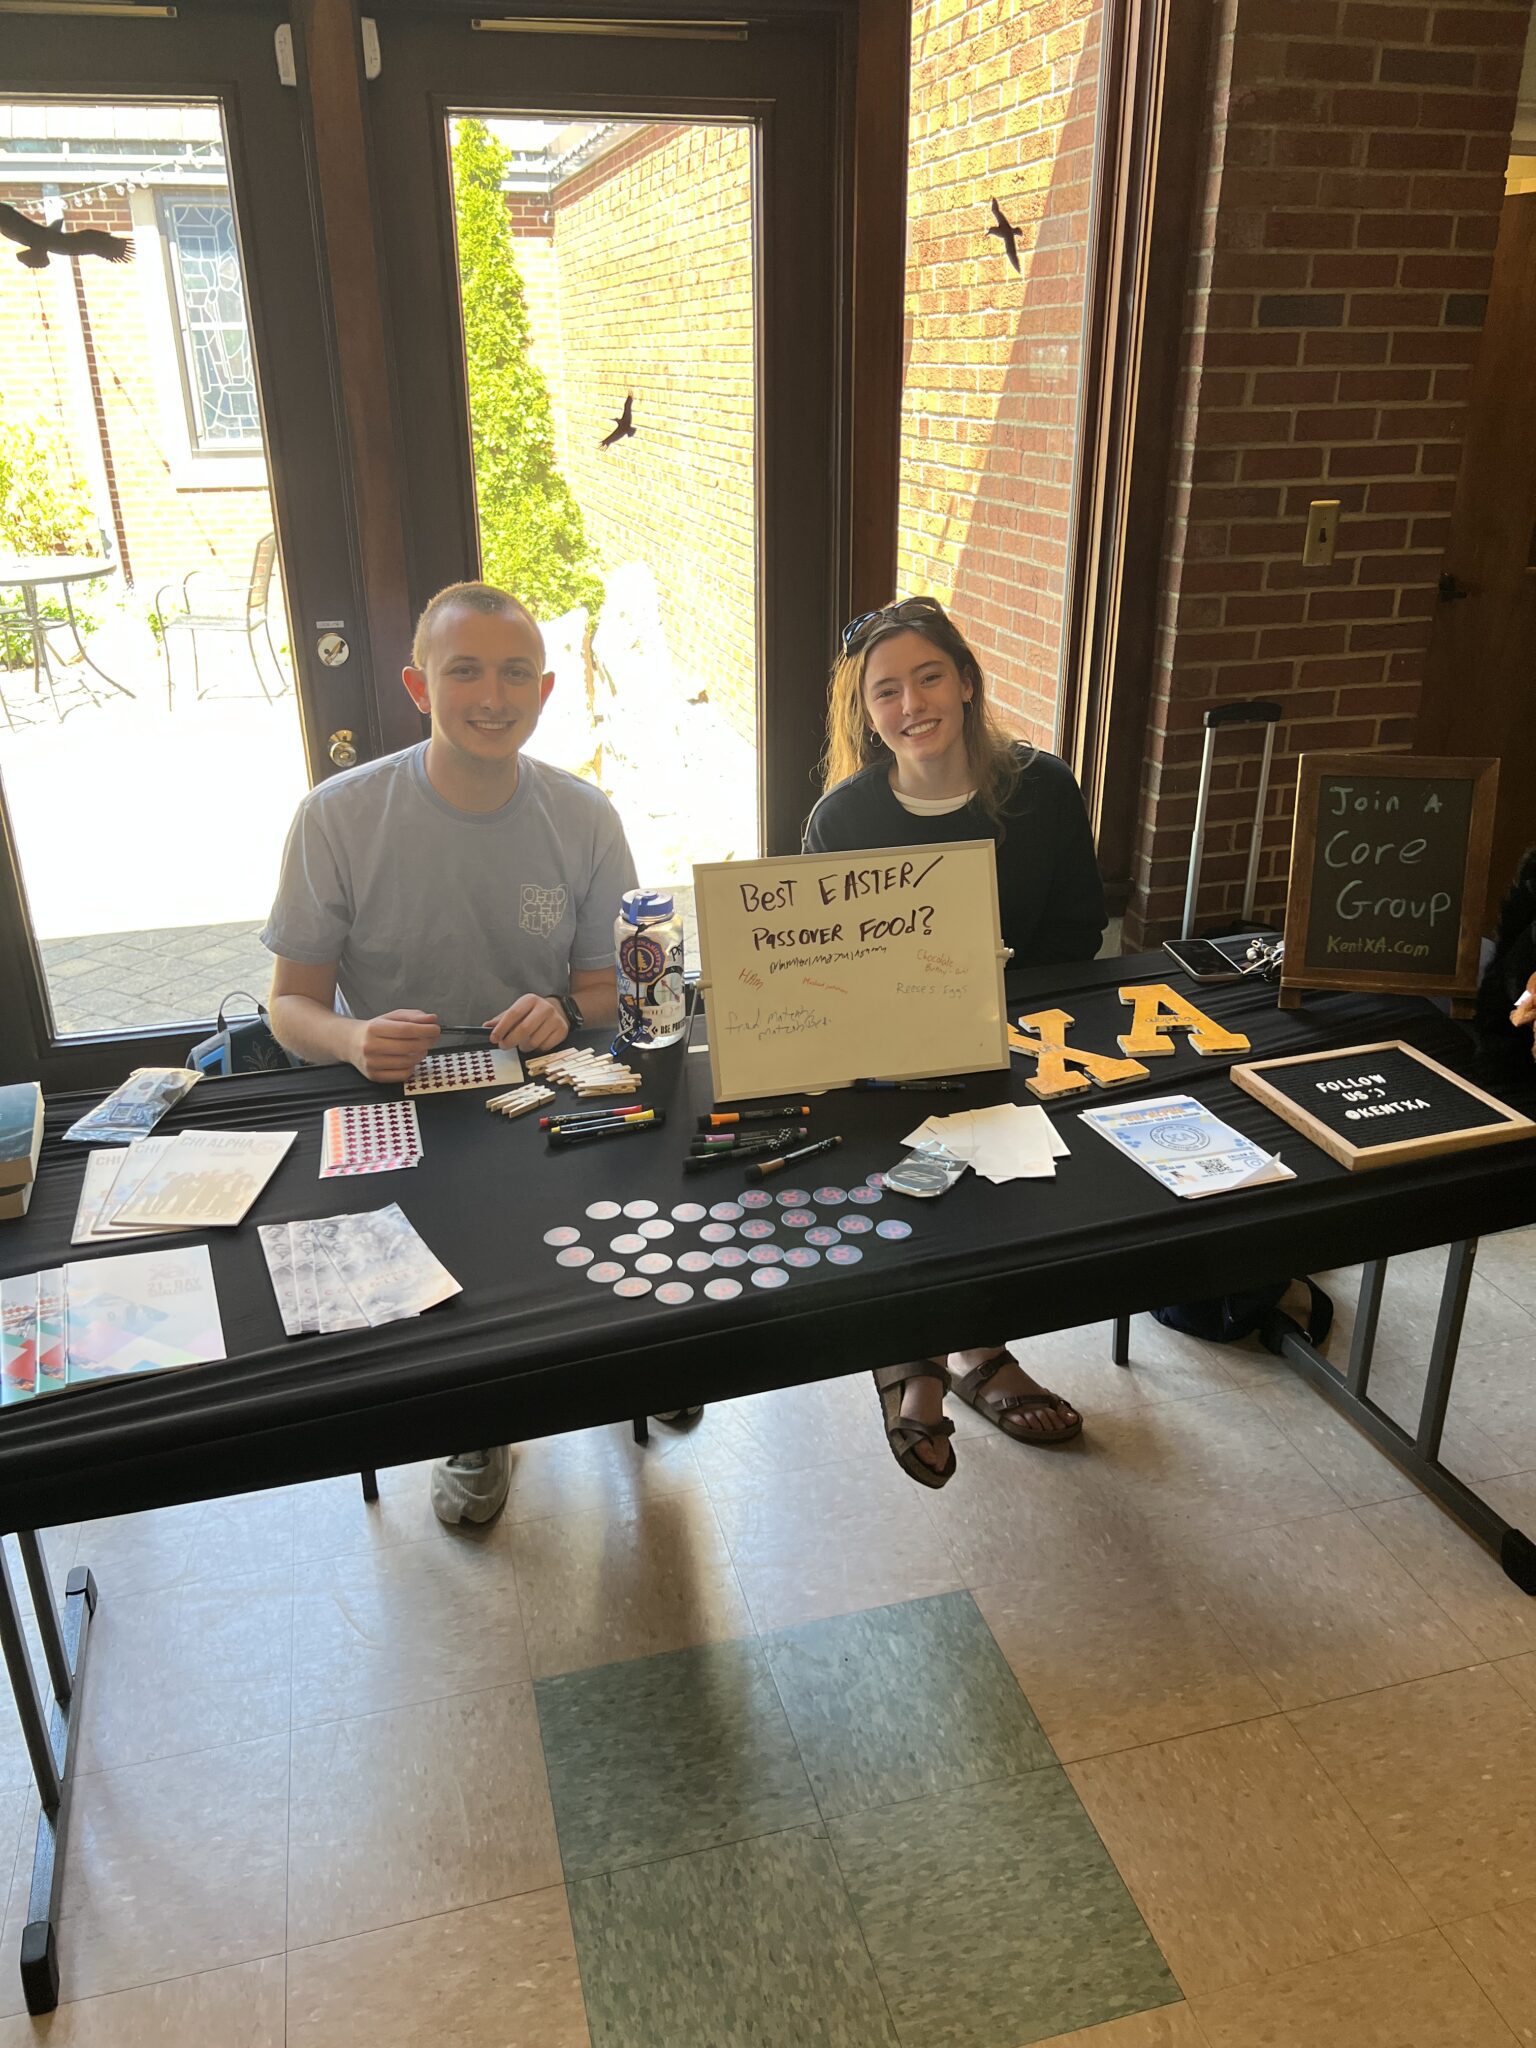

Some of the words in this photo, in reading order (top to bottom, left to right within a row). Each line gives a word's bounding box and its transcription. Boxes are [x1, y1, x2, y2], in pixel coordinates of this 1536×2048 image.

[1329, 786, 1400, 816] Join
[1423, 793, 1443, 814] A
[1324, 830, 1428, 868] Core
[818, 855, 944, 905] EASTER/
[522, 887, 566, 903] OHIO
[1336, 879, 1452, 928] Group
[522, 902, 562, 914] CHI
[521, 914, 562, 931] ALPHA
[659, 1023, 671, 1034] USE
[1315, 1073, 1387, 1094] FOLLOW
[1341, 1090, 1369, 1103] US
[1344, 1098, 1431, 1121] @KENTXA
[180, 1135, 208, 1147] CHI
[209, 1136, 254, 1149] ALPHA
